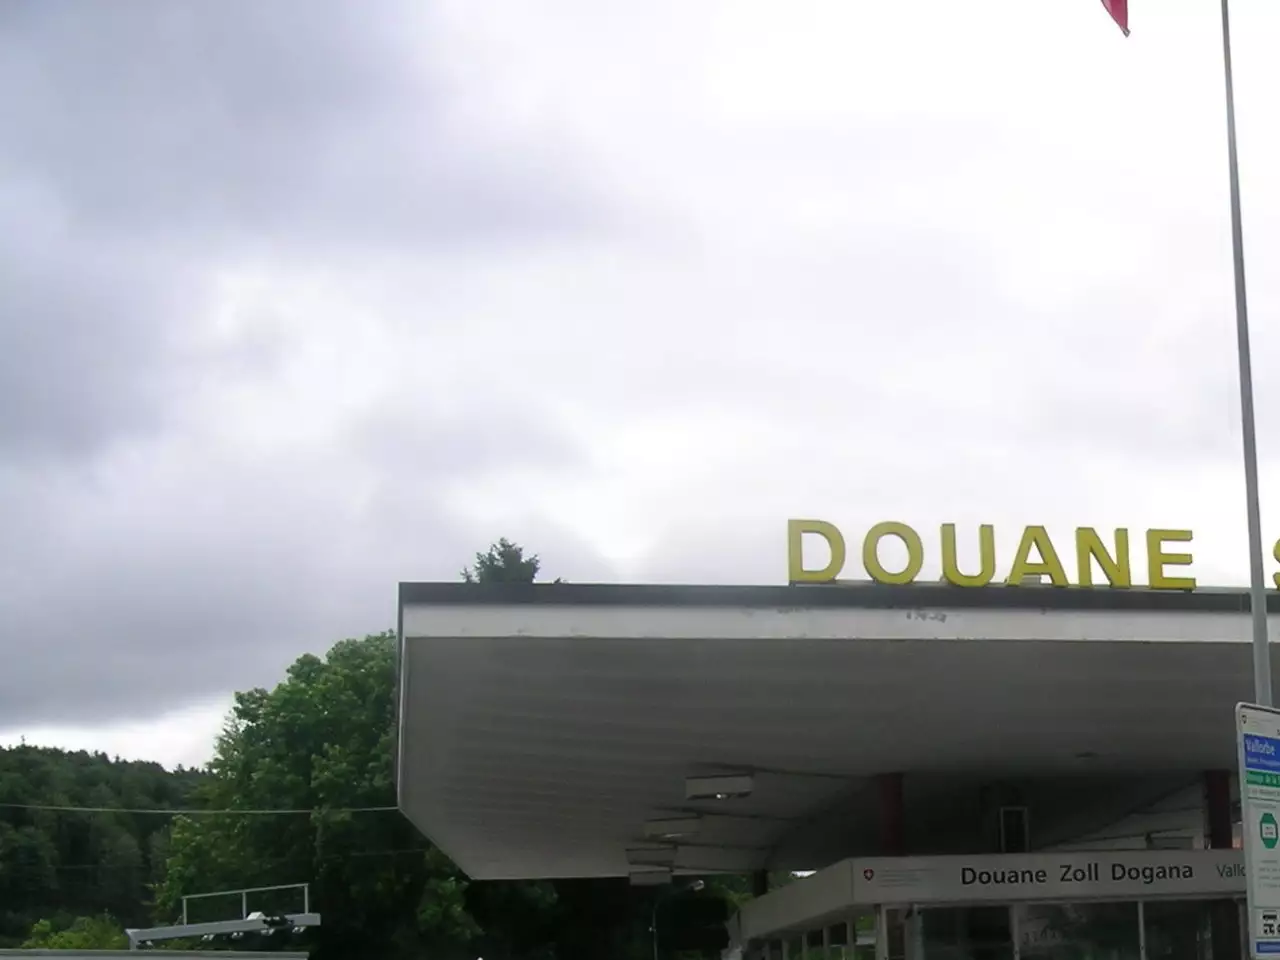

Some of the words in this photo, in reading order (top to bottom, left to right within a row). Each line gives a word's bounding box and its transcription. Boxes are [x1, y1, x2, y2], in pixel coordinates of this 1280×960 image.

[787, 518, 1196, 591] DOUANE
[960, 866, 1047, 885] Douane
[1059, 863, 1100, 882] Zoll
[1111, 861, 1194, 885] Dogana
